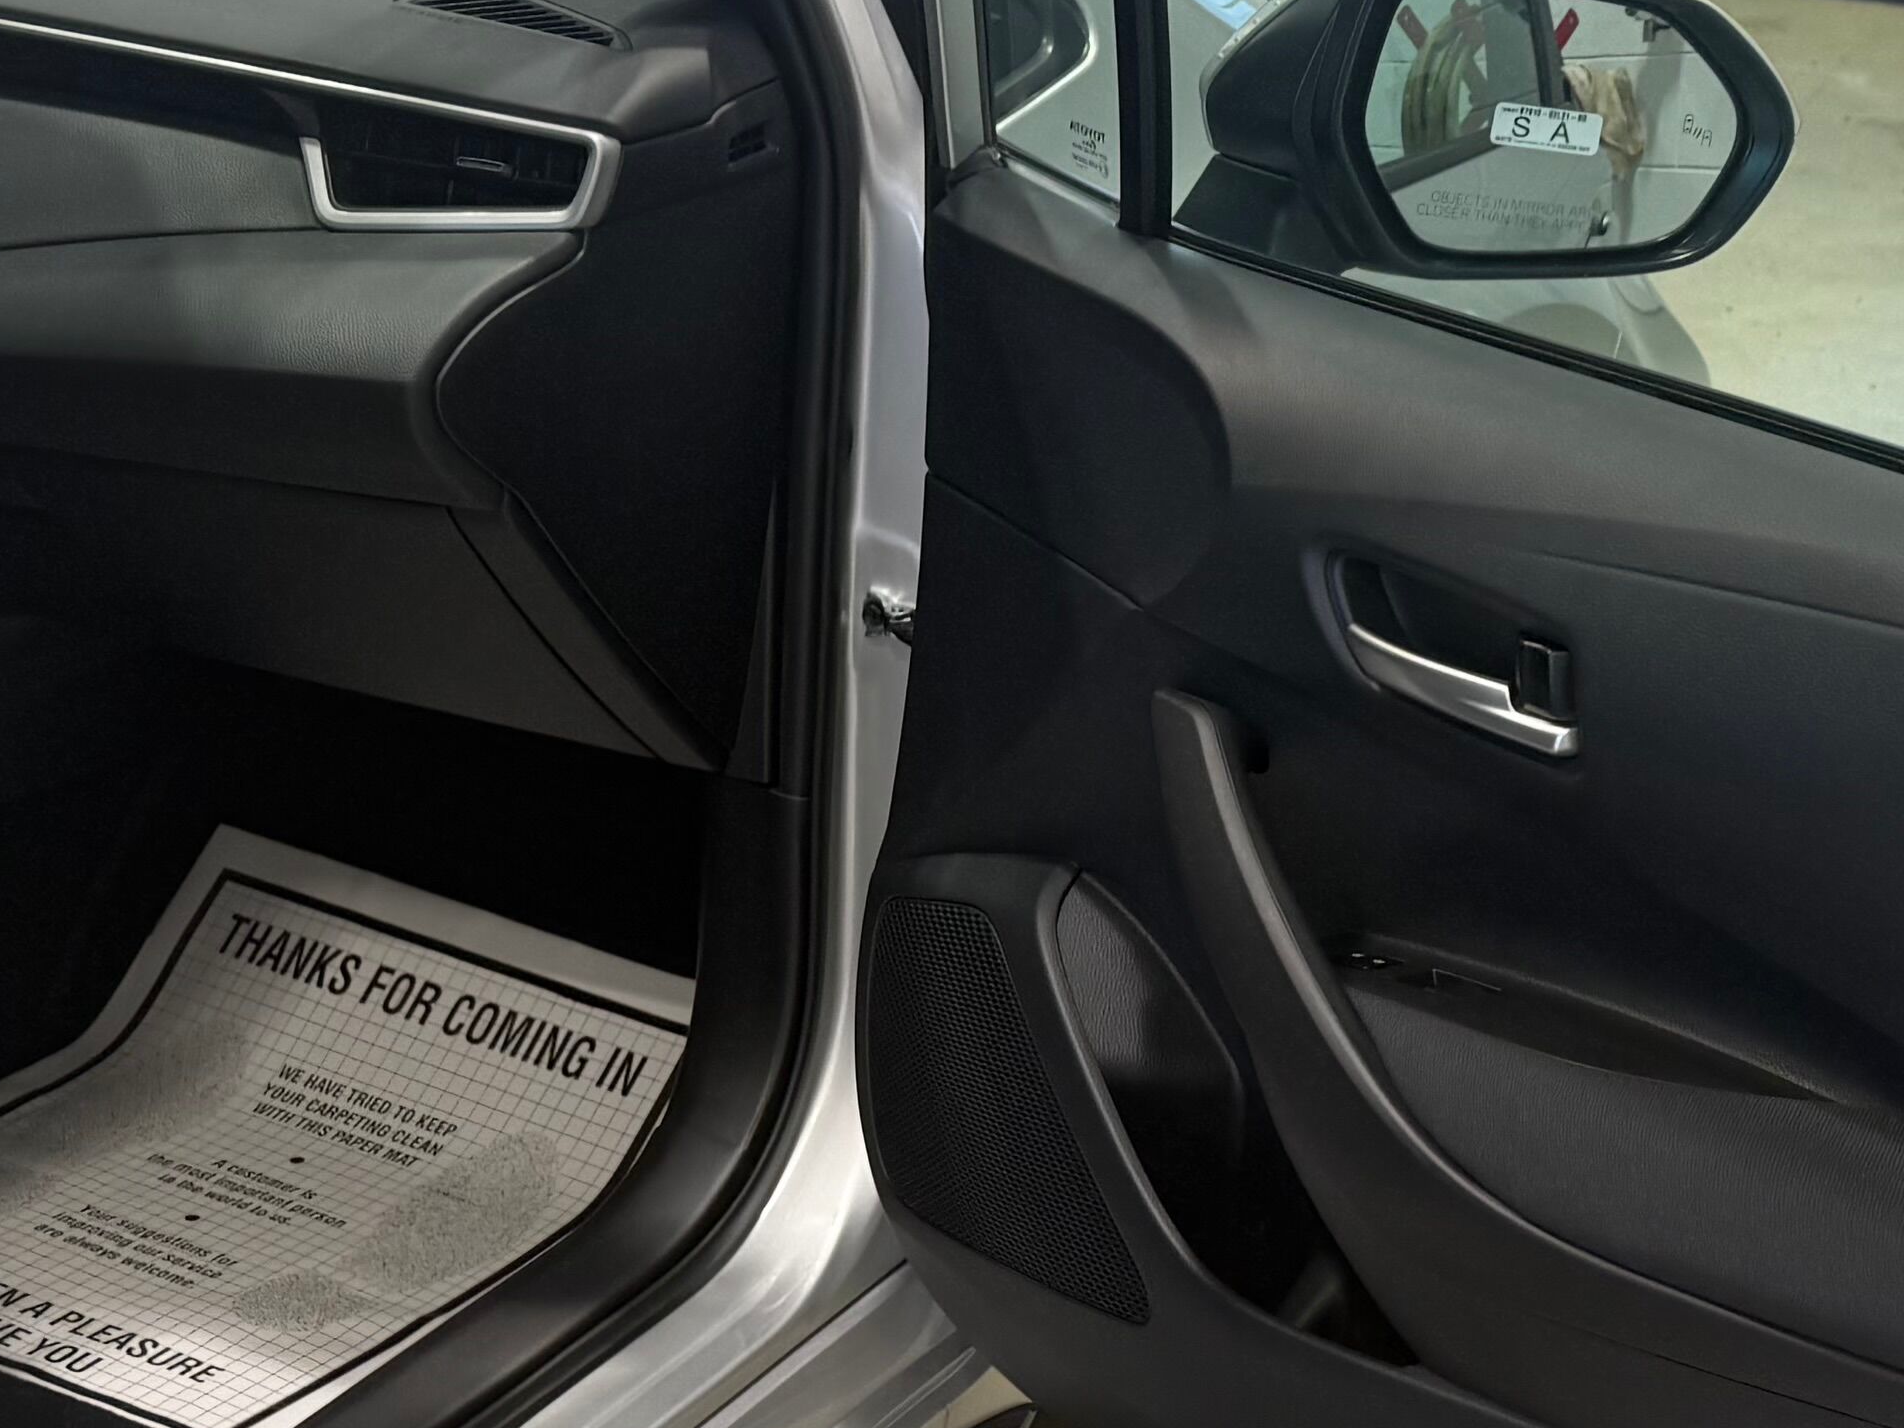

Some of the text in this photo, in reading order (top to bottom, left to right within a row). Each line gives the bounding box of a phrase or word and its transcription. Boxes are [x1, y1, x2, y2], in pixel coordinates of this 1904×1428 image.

[1512, 116, 1530, 138] S
[1550, 121, 1569, 144] A
[1416, 203, 1472, 221] CLOSER
[1431, 190, 1490, 208] OBJECTS
[219, 914, 648, 1098] THANKS FOR COMING IN
[263, 1082, 444, 1157] YOUR CARPETING CLEAN
[278, 1063, 458, 1137] WE HAVE TRIED TO KEEP
[253, 1102, 420, 1169] WITH THIS PAPER MAT
[146, 1153, 347, 1229] the most important person
[177, 1179, 204, 1194] the
[204, 1190, 253, 1210] world
[211, 1159, 318, 1200] A customer is
[34, 1223, 64, 1238] are
[63, 1235, 121, 1260] always
[51, 1211, 222, 1279] improving our service
[80, 1203, 238, 1267] Your suggestions for
[19, 1300, 56, 1320] A
[48, 1310, 225, 1384] PLEASURE
[27, 1336, 104, 1373] YOU
